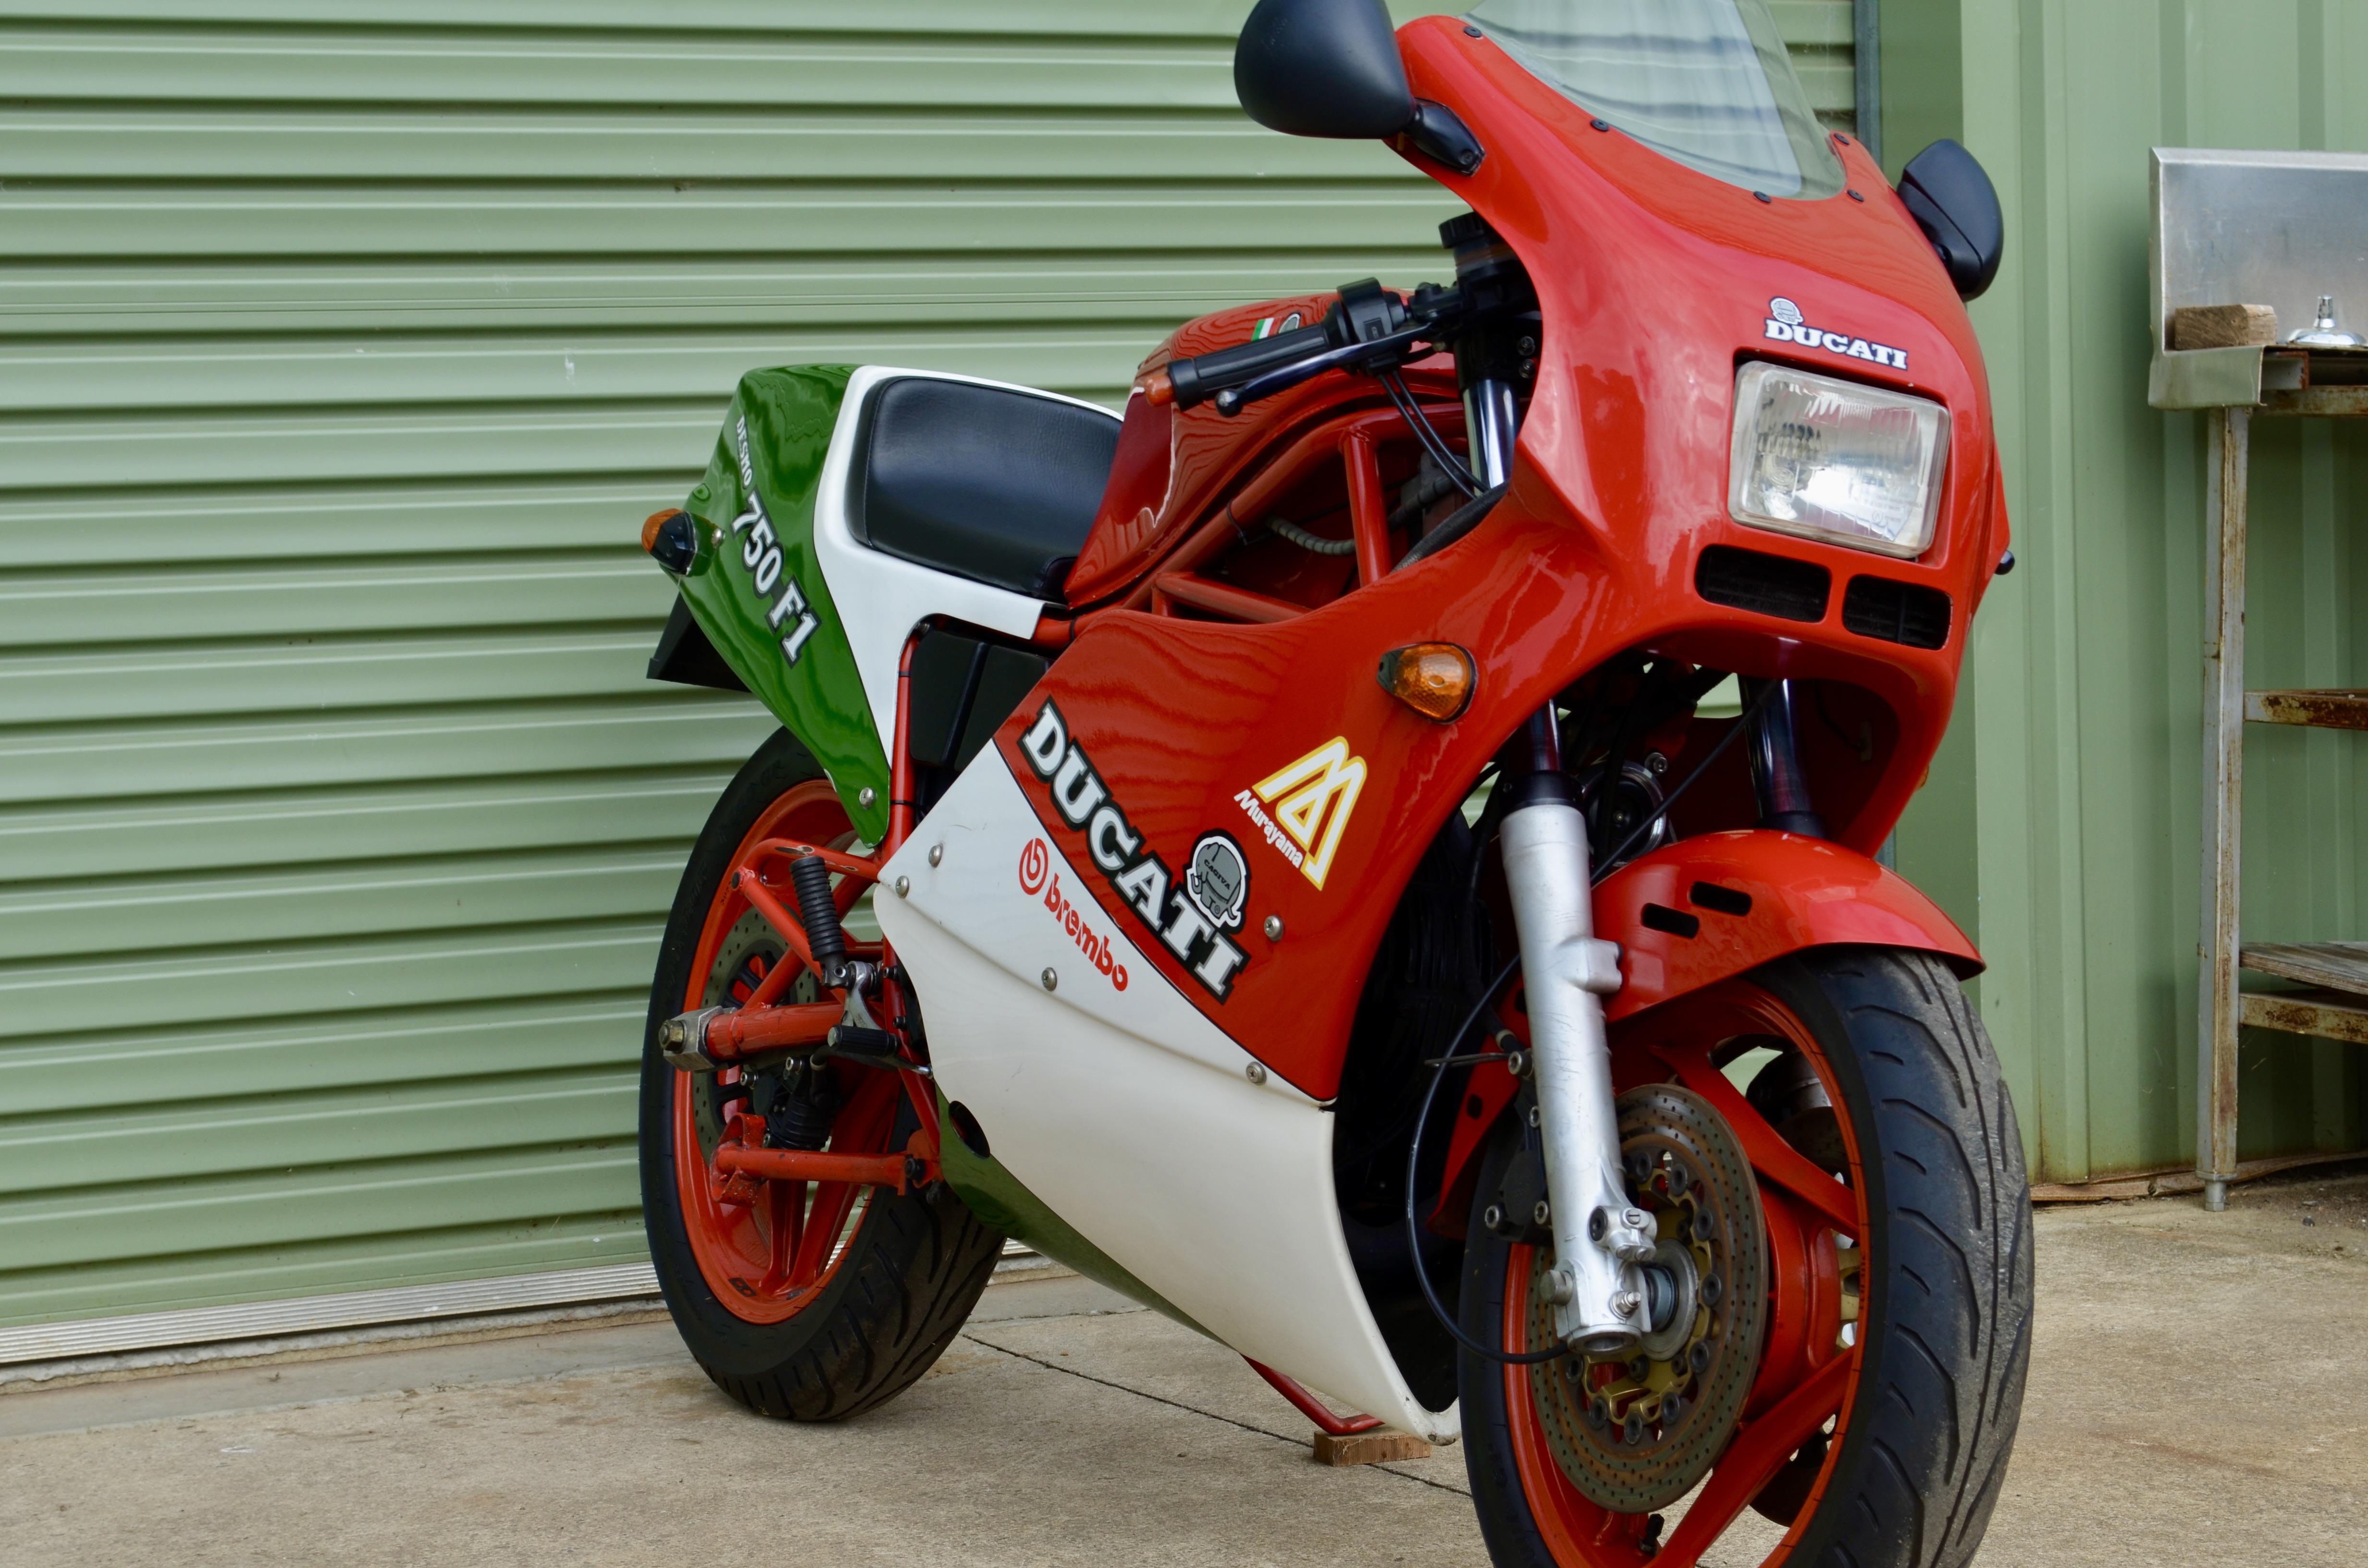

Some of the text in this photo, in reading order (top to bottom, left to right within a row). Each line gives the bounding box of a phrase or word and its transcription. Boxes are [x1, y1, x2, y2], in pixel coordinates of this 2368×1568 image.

[1764, 318, 1908, 370] DUCATI
[735, 415, 754, 489] DESMO
[732, 493, 821, 665] 750 F1
[1020, 701, 1245, 998] DUCATI
[1233, 788, 1305, 870] Murayama
[1204, 859, 1230, 890] CAGIVA
[1044, 874, 1129, 992] brembo
